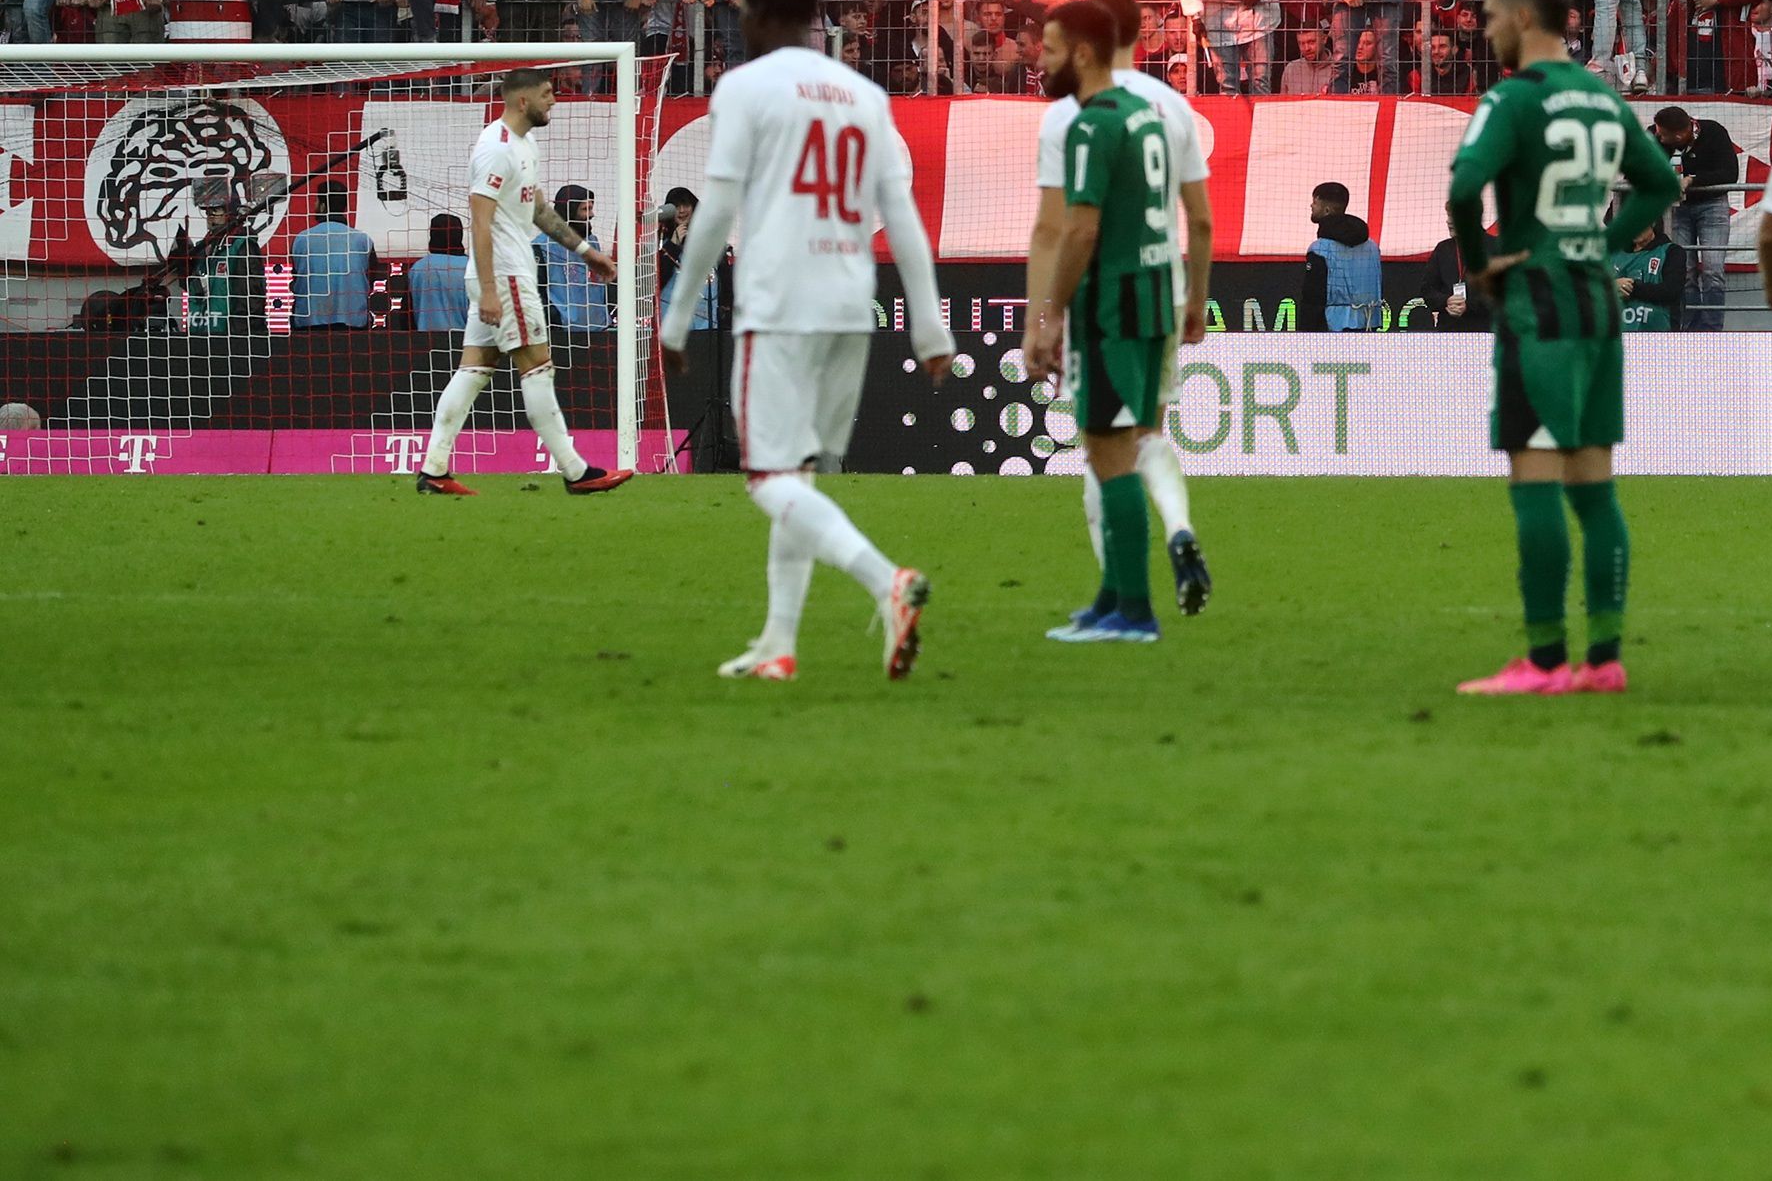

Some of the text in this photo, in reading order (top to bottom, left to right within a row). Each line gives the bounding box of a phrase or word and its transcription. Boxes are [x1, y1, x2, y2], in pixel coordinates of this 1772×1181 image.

[792, 117, 867, 225] 40
[1141, 132, 1170, 232] 9
[1534, 117, 1626, 232] 29
